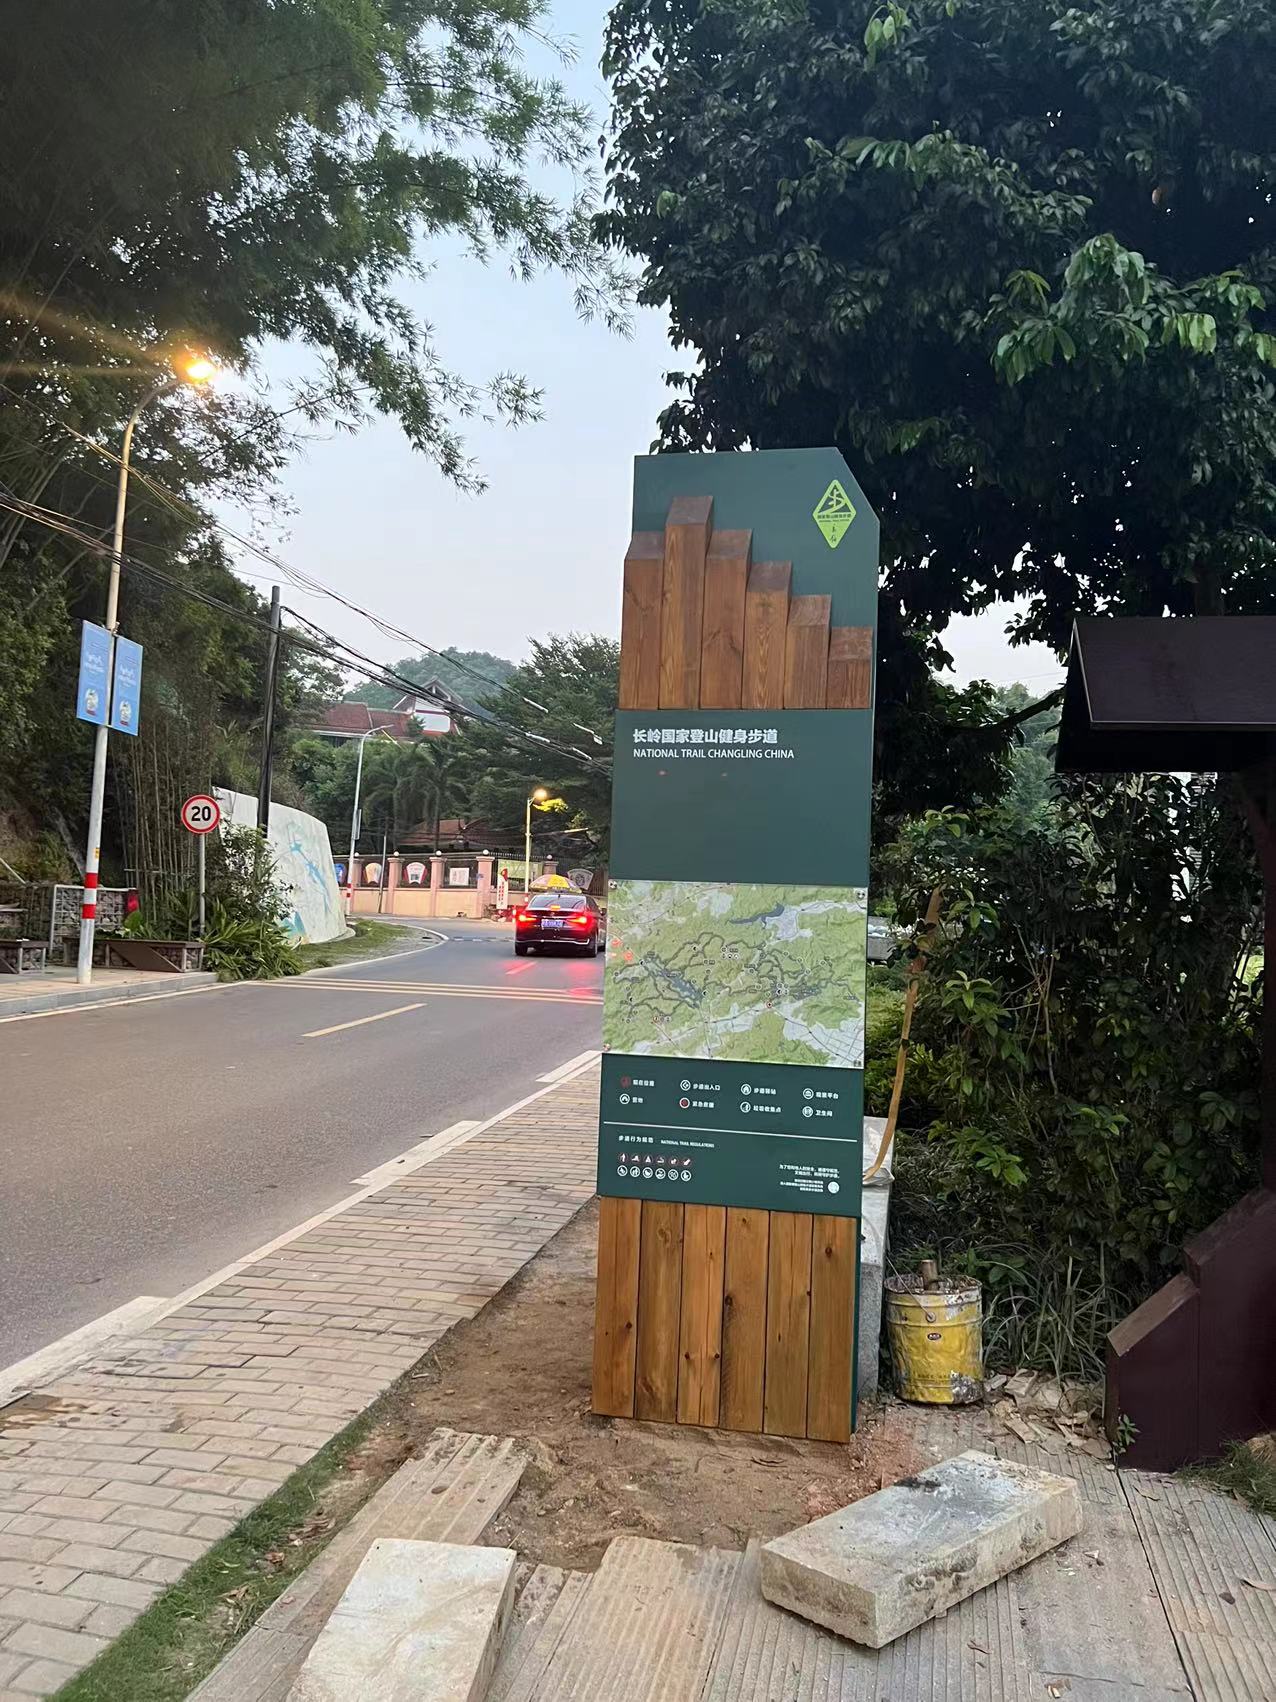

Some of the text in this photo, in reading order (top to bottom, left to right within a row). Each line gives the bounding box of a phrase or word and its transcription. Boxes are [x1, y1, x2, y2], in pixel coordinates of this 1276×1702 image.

[633, 728, 778, 744] 长岭国家登山健身步道
[633, 749, 795, 759] NATIONAL TRAIL CHANGLING CHINA
[191, 805, 212, 822] 20
